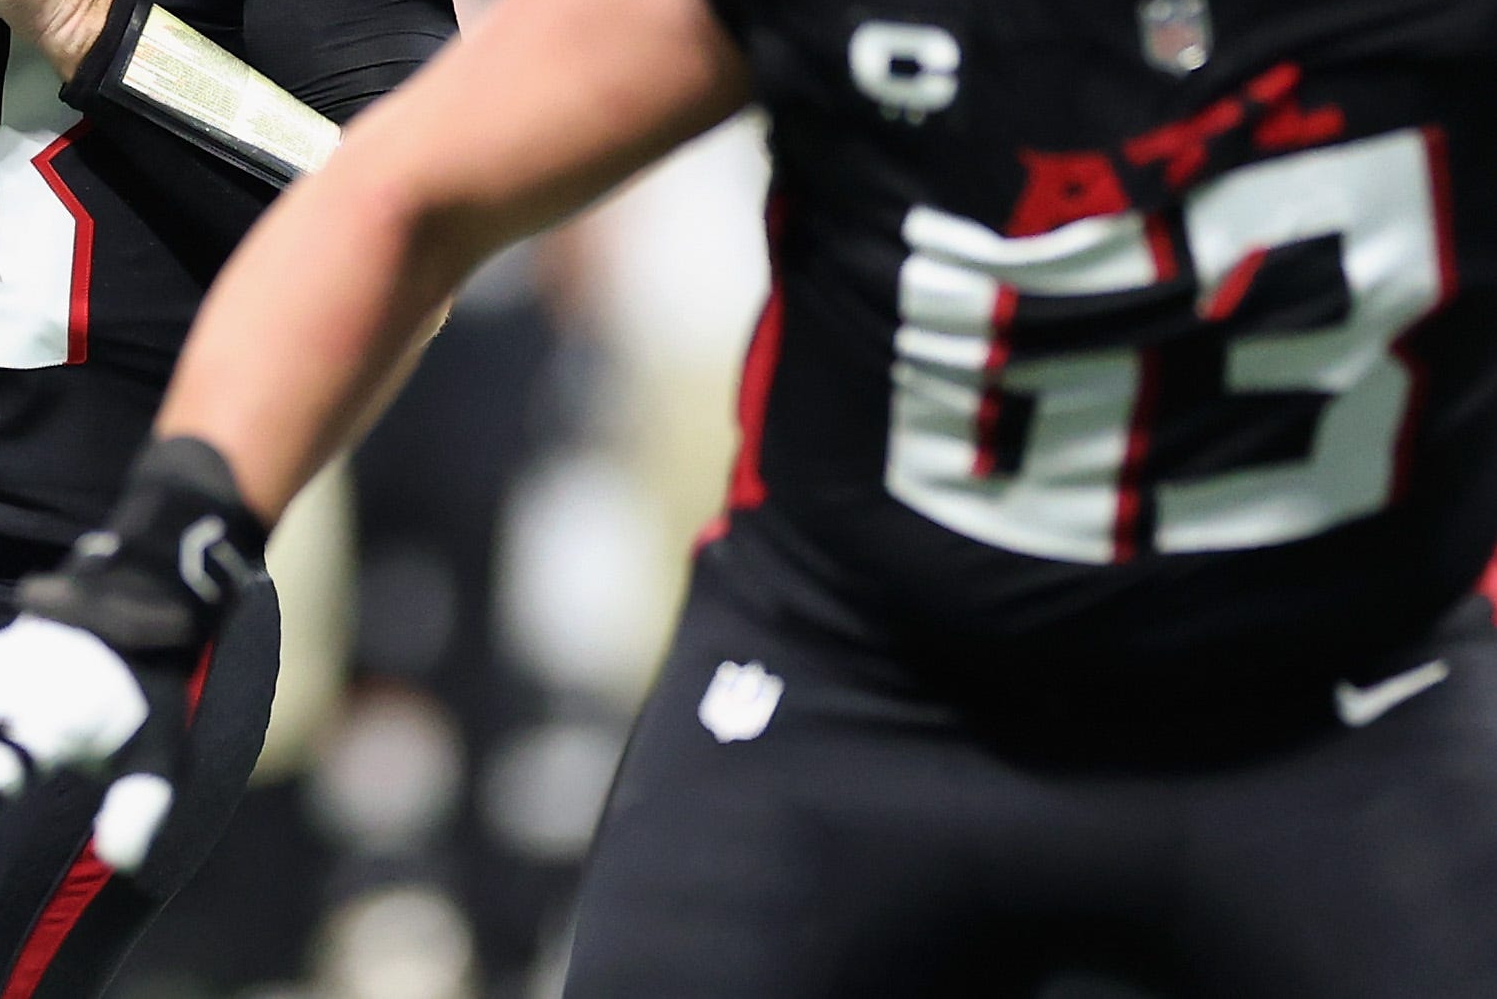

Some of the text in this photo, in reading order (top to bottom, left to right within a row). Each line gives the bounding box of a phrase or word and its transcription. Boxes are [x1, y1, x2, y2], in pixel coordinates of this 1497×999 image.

[848, 19, 962, 114] C
[1004, 62, 1346, 239] ATL
[884, 125, 1459, 565] 63
